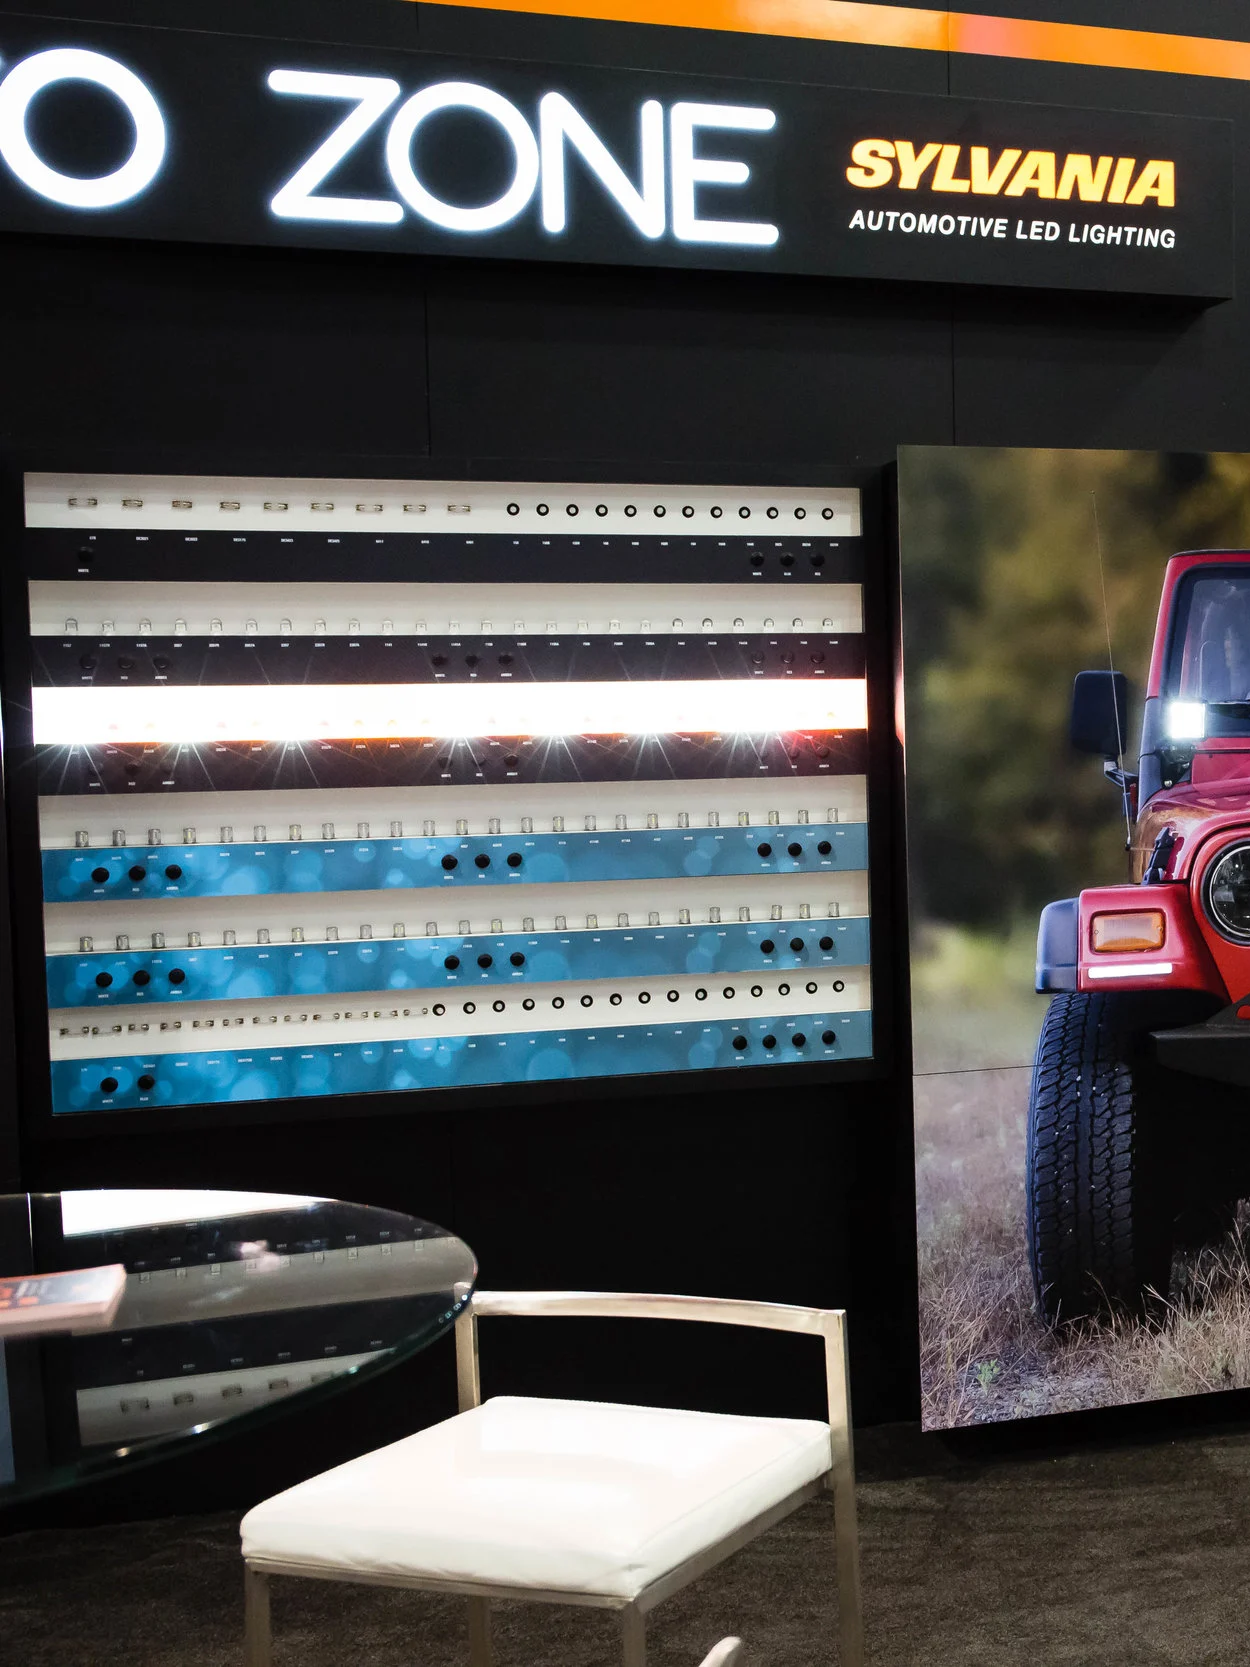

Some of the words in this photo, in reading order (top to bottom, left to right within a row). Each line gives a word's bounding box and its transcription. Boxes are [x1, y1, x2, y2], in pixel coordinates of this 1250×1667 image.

[0, 48, 167, 208] O
[267, 68, 780, 246] ZONE
[846, 139, 1175, 207] SYLVANIA
[849, 209, 1009, 239] AUTOMOTIVE
[1015, 219, 1061, 242] LED
[1068, 223, 1176, 249] LIGHTING
